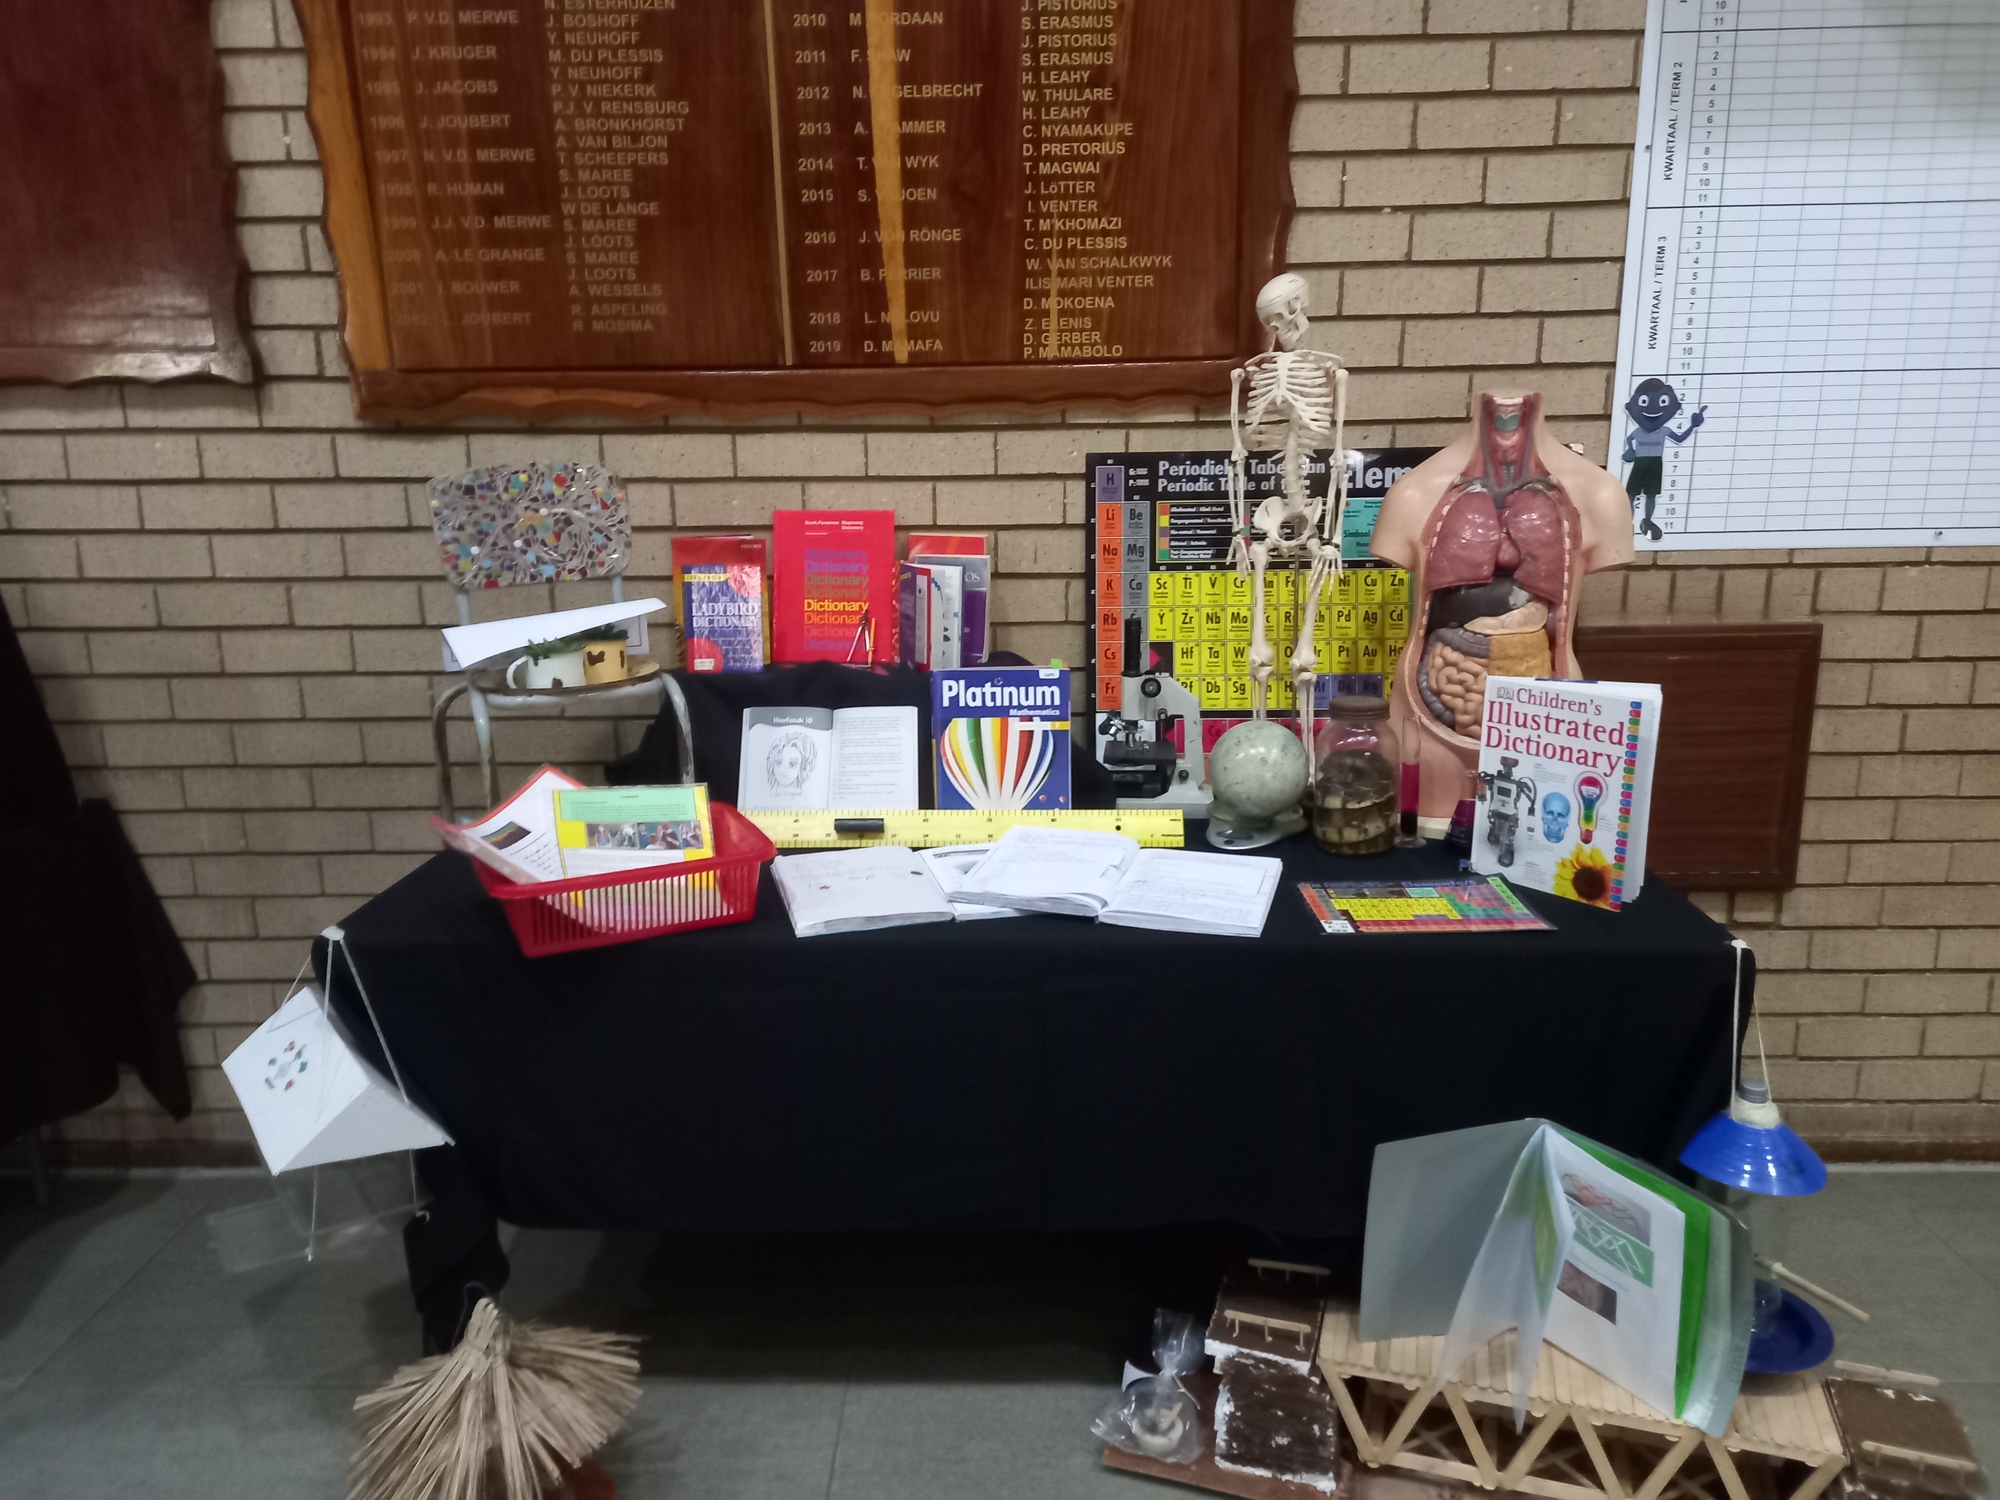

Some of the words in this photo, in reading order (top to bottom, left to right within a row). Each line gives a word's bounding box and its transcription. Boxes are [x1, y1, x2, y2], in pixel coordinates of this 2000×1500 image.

[1038, 0, 1117, 12] PISTORIUS
[458, 10, 519, 25] MERWE
[563, 13, 640, 28] BOSHOFF
[793, 13, 826, 27] 2010
[1021, 16, 1035, 30] S.
[1039, 15, 1114, 30] ERASMUS
[565, 31, 640, 45] NEUHOFF
[1021, 34, 1034, 48] J.
[1038, 33, 1117, 48] PISTORIUS
[429, 45, 497, 60] KRUGER
[571, 49, 592, 62] DU
[598, 49, 663, 63] PLESSIS
[795, 50, 826, 63] 2011
[1022, 53, 1036, 66] S.
[1039, 51, 1114, 66] ERASMUS
[1713, 51, 1719, 60] 2
[568, 66, 643, 80] NEUHOFF
[1022, 71, 1037, 84] H.
[1041, 70, 1091, 84] LEAHY
[433, 79, 498, 94] JACOBS
[587, 84, 657, 97] NIEKERK
[797, 86, 830, 99] 2012
[1670, 72, 1682, 105] TERM
[1709, 83, 1716, 92] 4
[1022, 89, 1039, 102] W.
[1043, 87, 1114, 101] THULARE
[601, 101, 689, 115] RENSBURG
[1708, 99, 1715, 108] 5
[1022, 107, 1037, 120] H.
[1041, 106, 1091, 120] LEAHY
[438, 114, 511, 128] JOUBERT
[575, 118, 685, 132] BRONKHORST
[799, 122, 832, 136] 2013
[1022, 124, 1037, 138] C.
[1041, 123, 1134, 138] NYAMAKUPE
[576, 135, 607, 148] VAN
[612, 135, 668, 149] BILJON
[1022, 143, 1037, 157] D.
[1041, 141, 1126, 156] PRETORIUS
[1663, 114, 1678, 181] KWARTAAL
[476, 148, 535, 163] MERWE
[574, 152, 669, 166] SCHEEPERS
[798, 157, 834, 171] 2014
[905, 155, 939, 169] WYK
[1023, 161, 1037, 175] T.
[1039, 161, 1100, 175] MAGWAI
[578, 168, 633, 182] MAREE
[446, 182, 504, 196] HUMAN
[578, 185, 630, 199] LOOTS
[801, 188, 834, 201] 2015
[1024, 181, 1036, 194] J.
[580, 202, 601, 215] DE
[606, 202, 660, 215] LANGE
[1039, 199, 1098, 213] VENTER
[494, 214, 553, 229] MERWE
[582, 218, 637, 232] MAREE
[1023, 219, 1035, 231] T.
[582, 235, 634, 248] LOOTS
[804, 231, 836, 244] 2016
[910, 226, 962, 242] RÖNGE
[1024, 238, 1038, 251] C.
[1042, 237, 1063, 250] DU
[1067, 236, 1128, 250] PLESSIS
[478, 248, 545, 262] GRANGE
[585, 251, 640, 265] MAREE
[1654, 245, 1666, 278] TERM
[1026, 258, 1042, 271] W.
[1046, 257, 1076, 270] VAN
[1080, 255, 1173, 270] SCHALKWYK
[585, 268, 637, 281] LOOTS
[806, 269, 839, 282] 2017
[1097, 275, 1154, 288] VENTER
[588, 284, 663, 297] WESSELS
[591, 302, 668, 316] ASPELING
[1023, 298, 1037, 310] D.
[1041, 296, 1115, 310] MOKOENA
[809, 312, 841, 324] 2018
[1024, 318, 1037, 330] Z.
[1648, 287, 1663, 350] KWARTAAL
[592, 319, 654, 332] MOSIMA
[1023, 333, 1036, 345] D.
[1041, 331, 1101, 345] GERBER
[809, 341, 841, 353] 2019
[1024, 347, 1035, 359] P.
[1039, 345, 1123, 359] MAMABOLO
[1106, 473, 1114, 486] H
[1157, 477, 1215, 492] Periodic
[1260, 475, 1276, 491] of
[1106, 508, 1115, 521] Li
[1129, 508, 1143, 521] Be
[1102, 543, 1117, 556] Na
[1127, 543, 1144, 559] Mg
[1106, 578, 1113, 591] K
[1129, 578, 1142, 591] Ca
[1156, 577, 1168, 590] Sc
[1183, 577, 1192, 589] Ti
[1209, 576, 1217, 588] V
[1364, 575, 1377, 587] Cu
[1390, 574, 1404, 587] Zn
[691, 602, 758, 616] LADYBIRD
[804, 599, 869, 613] Dictionary
[692, 616, 758, 628] DICTIONARY
[804, 612, 861, 625] Dictionar
[1103, 613, 1117, 626] Rb
[1181, 612, 1194, 625] Zr
[1206, 611, 1221, 624] Nb
[1231, 612, 1248, 624] Mo
[1363, 610, 1378, 624] Ag
[1390, 609, 1403, 622] Cd
[1104, 647, 1116, 660] Cs
[1181, 646, 1194, 659] Hf
[1208, 646, 1219, 659] Ta
[1363, 645, 1377, 657] Au
[942, 678, 1060, 707] Platinum
[1105, 682, 1116, 695] Fr
[1206, 680, 1221, 693] Db
[1232, 681, 1245, 696] Sg
[1517, 687, 1602, 716] Children's
[1009, 708, 1060, 716] Mathematics
[1487, 700, 1625, 747] Illustrated
[1485, 724, 1623, 778] Dictionary
